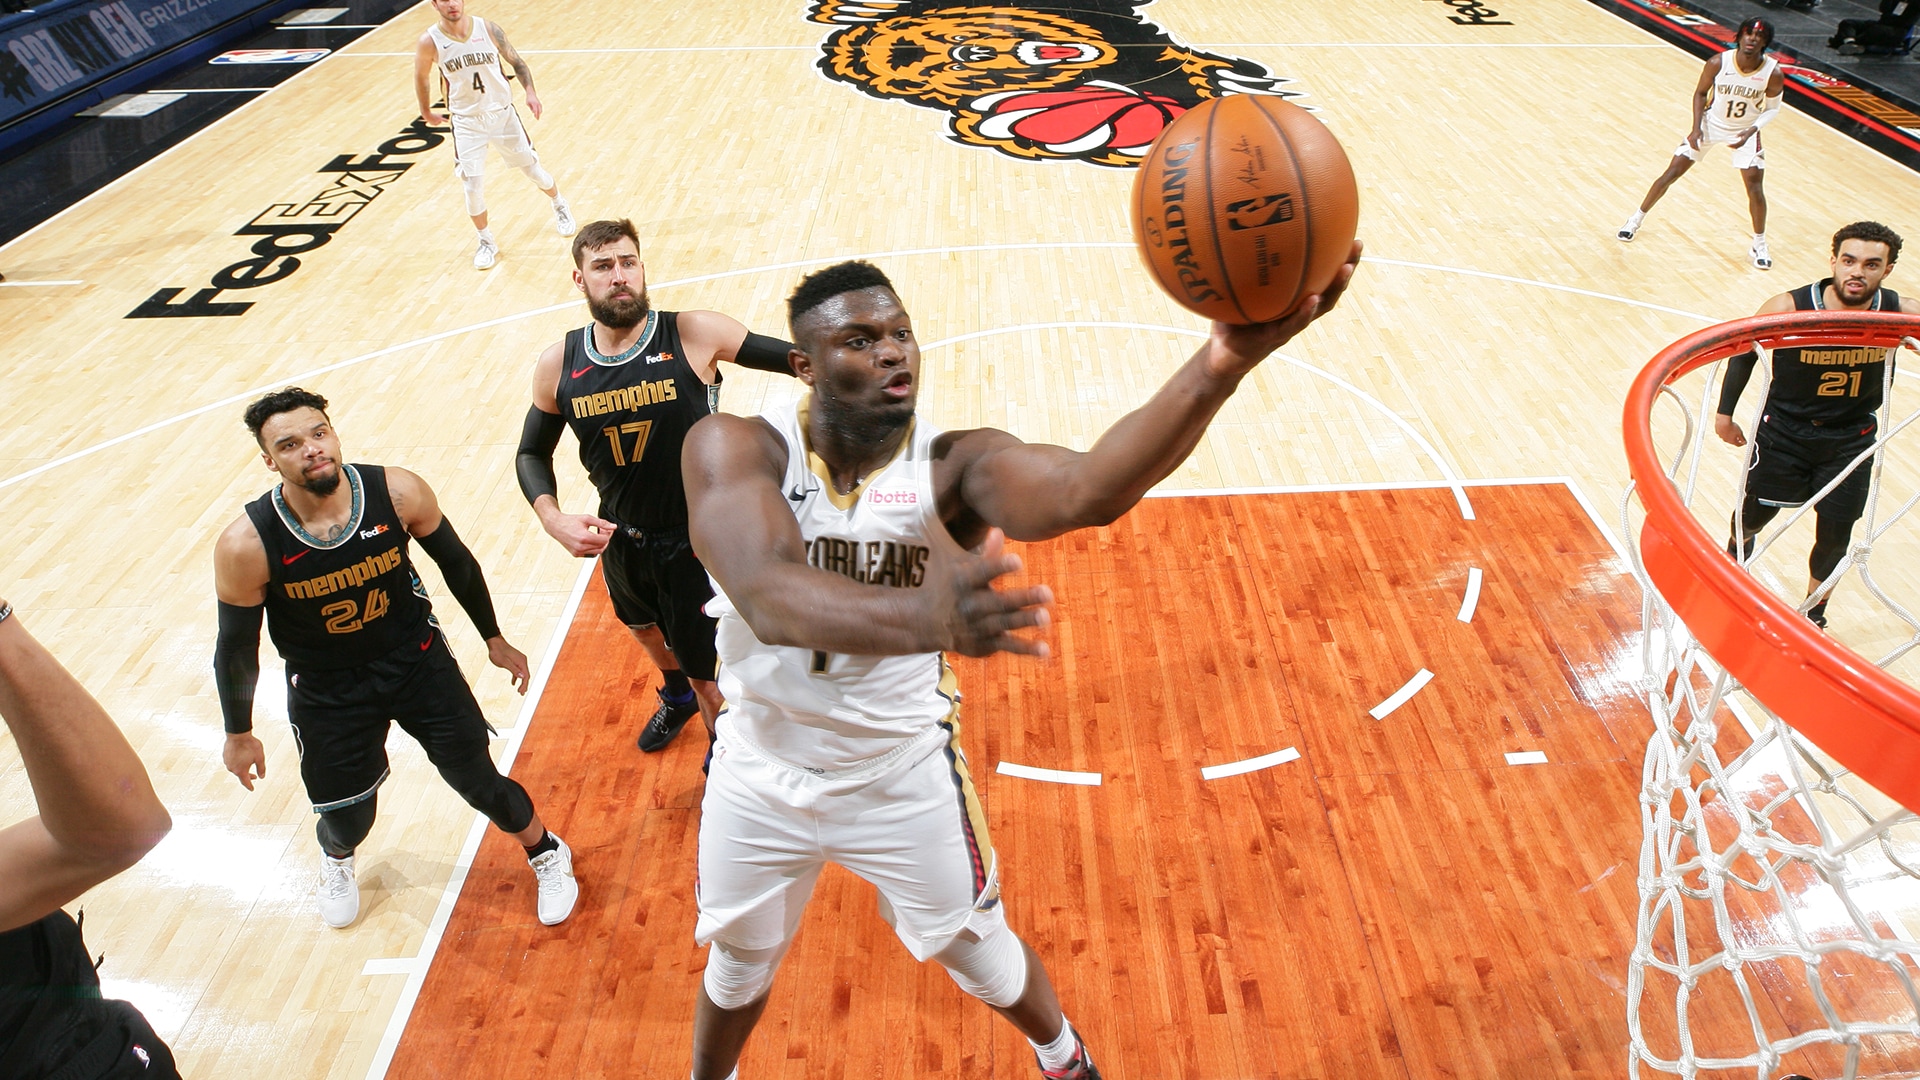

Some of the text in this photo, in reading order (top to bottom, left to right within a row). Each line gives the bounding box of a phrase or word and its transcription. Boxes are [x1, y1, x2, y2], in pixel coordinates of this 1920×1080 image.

[140, 0, 219, 28] GRIZZ
[444, 51, 495, 73] NEW ORLEANS
[472, 71, 485, 94] 4
[1733, 84, 1759, 100] ORLEAN
[1726, 100, 1747, 118] 13
[124, 96, 453, 318] FedExFor
[1162, 141, 1224, 304] SPALDING
[645, 351, 674, 365] FedEx
[1816, 370, 1863, 398] 21
[571, 378, 677, 419] memphis
[602, 419, 653, 467] 17
[868, 489, 917, 504] ibotta
[360, 523, 390, 540] FedEx
[283, 546, 402, 599] memphis
[810, 536, 930, 588] ORLEANS
[320, 588, 391, 634] 24
